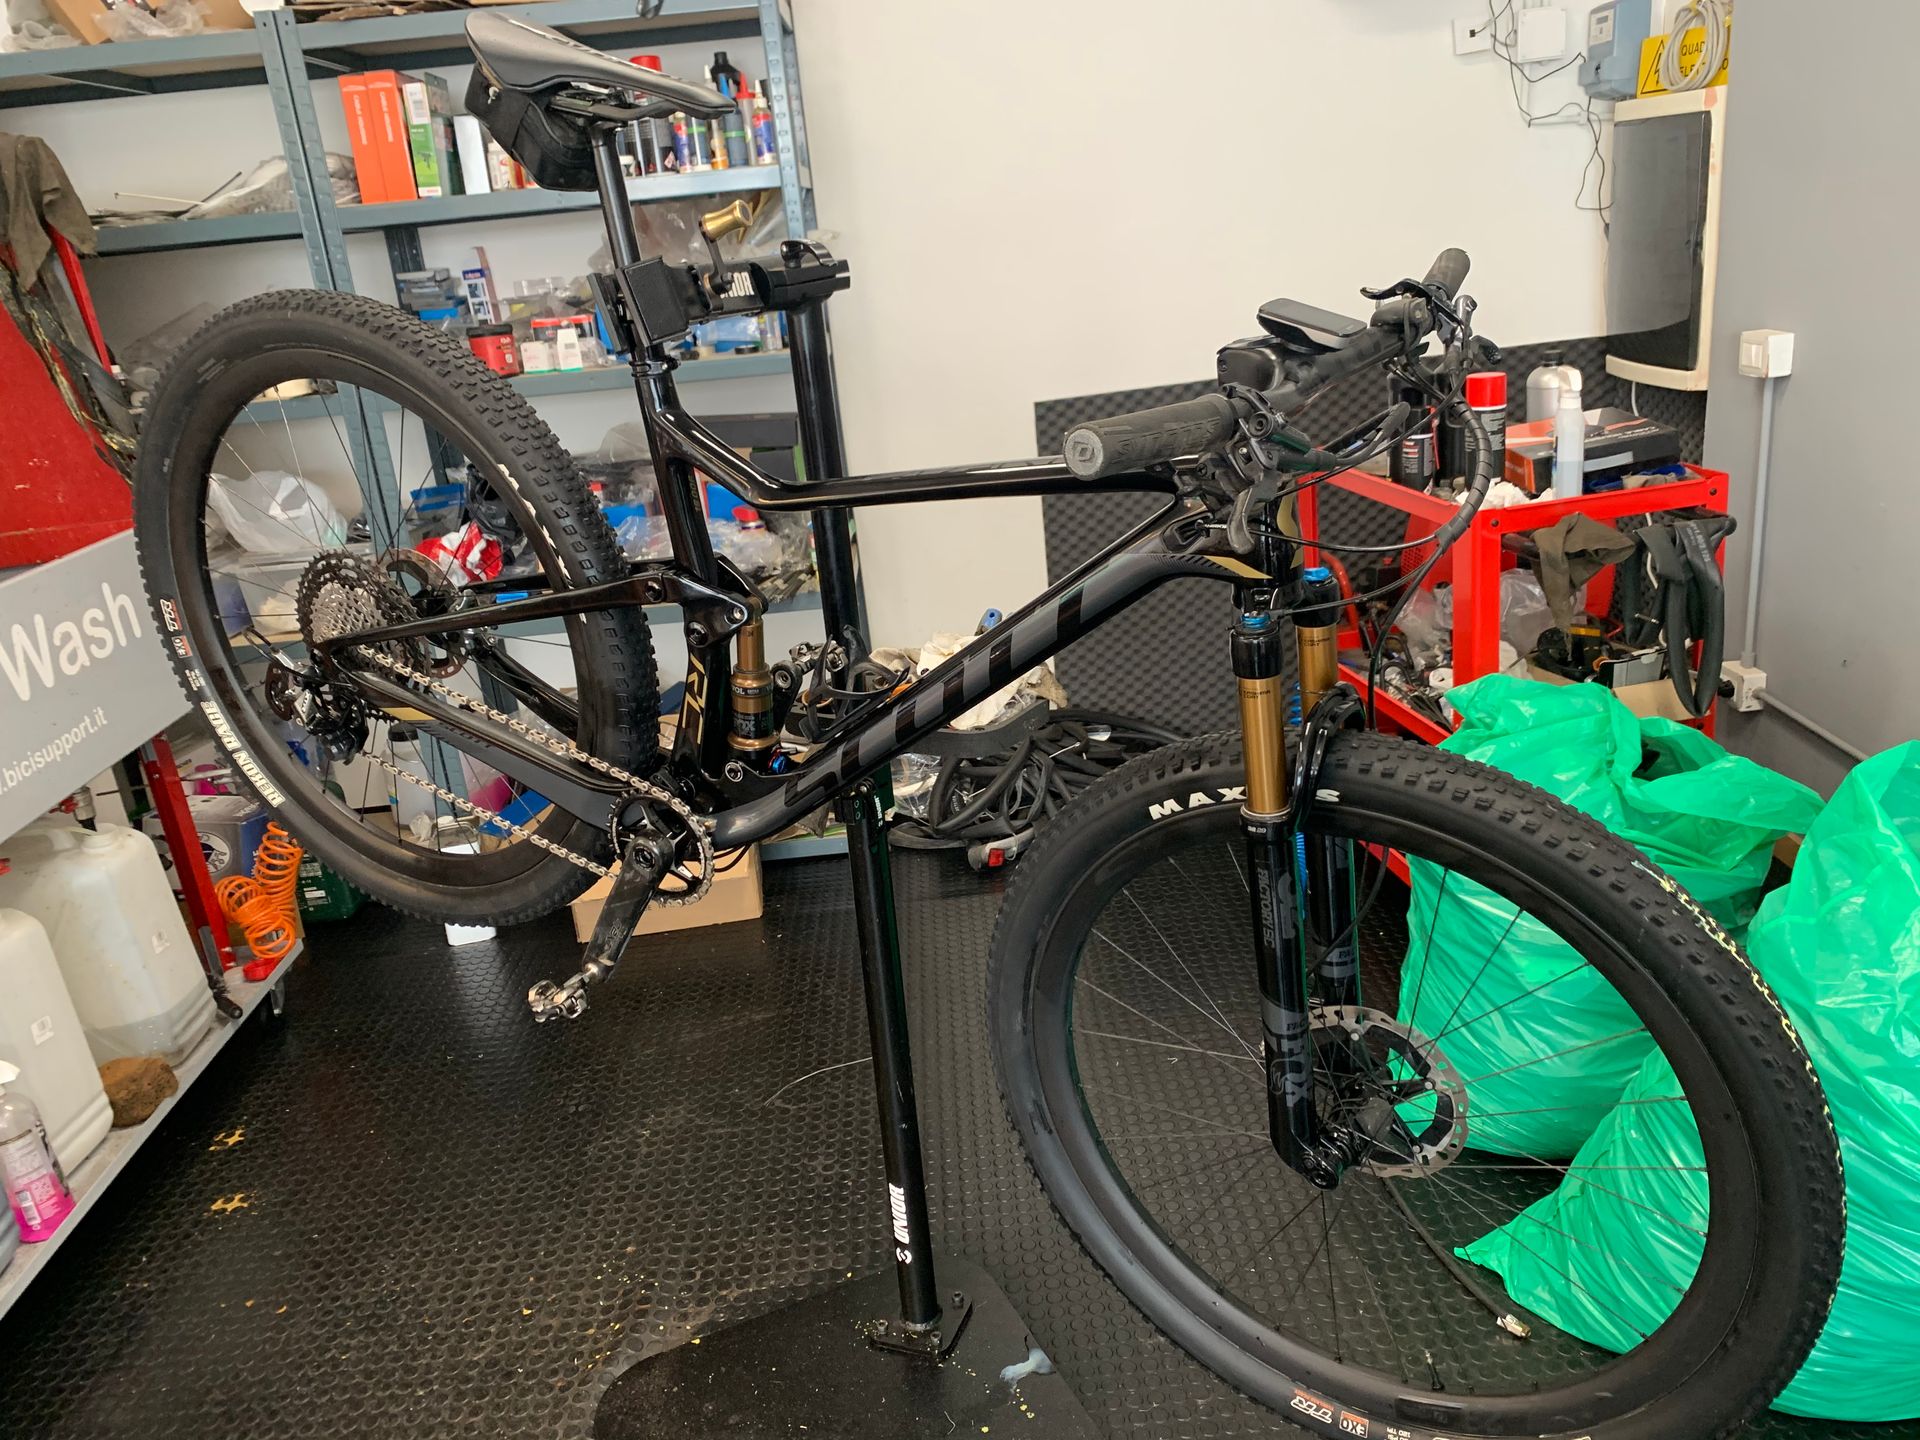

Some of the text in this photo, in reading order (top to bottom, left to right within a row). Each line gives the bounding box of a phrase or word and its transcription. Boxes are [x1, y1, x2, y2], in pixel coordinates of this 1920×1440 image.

[0, 582, 142, 701] Wash
[0, 706, 108, 796] .bicisupport.it
[201, 700, 242, 751] RACE
[233, 751, 286, 807] REKON
[1148, 786, 1341, 820] MAXS
[1257, 867, 1274, 928] FACTORY
[888, 1182, 910, 1245] UNIOR
[1340, 1416, 1367, 1437] EXO
